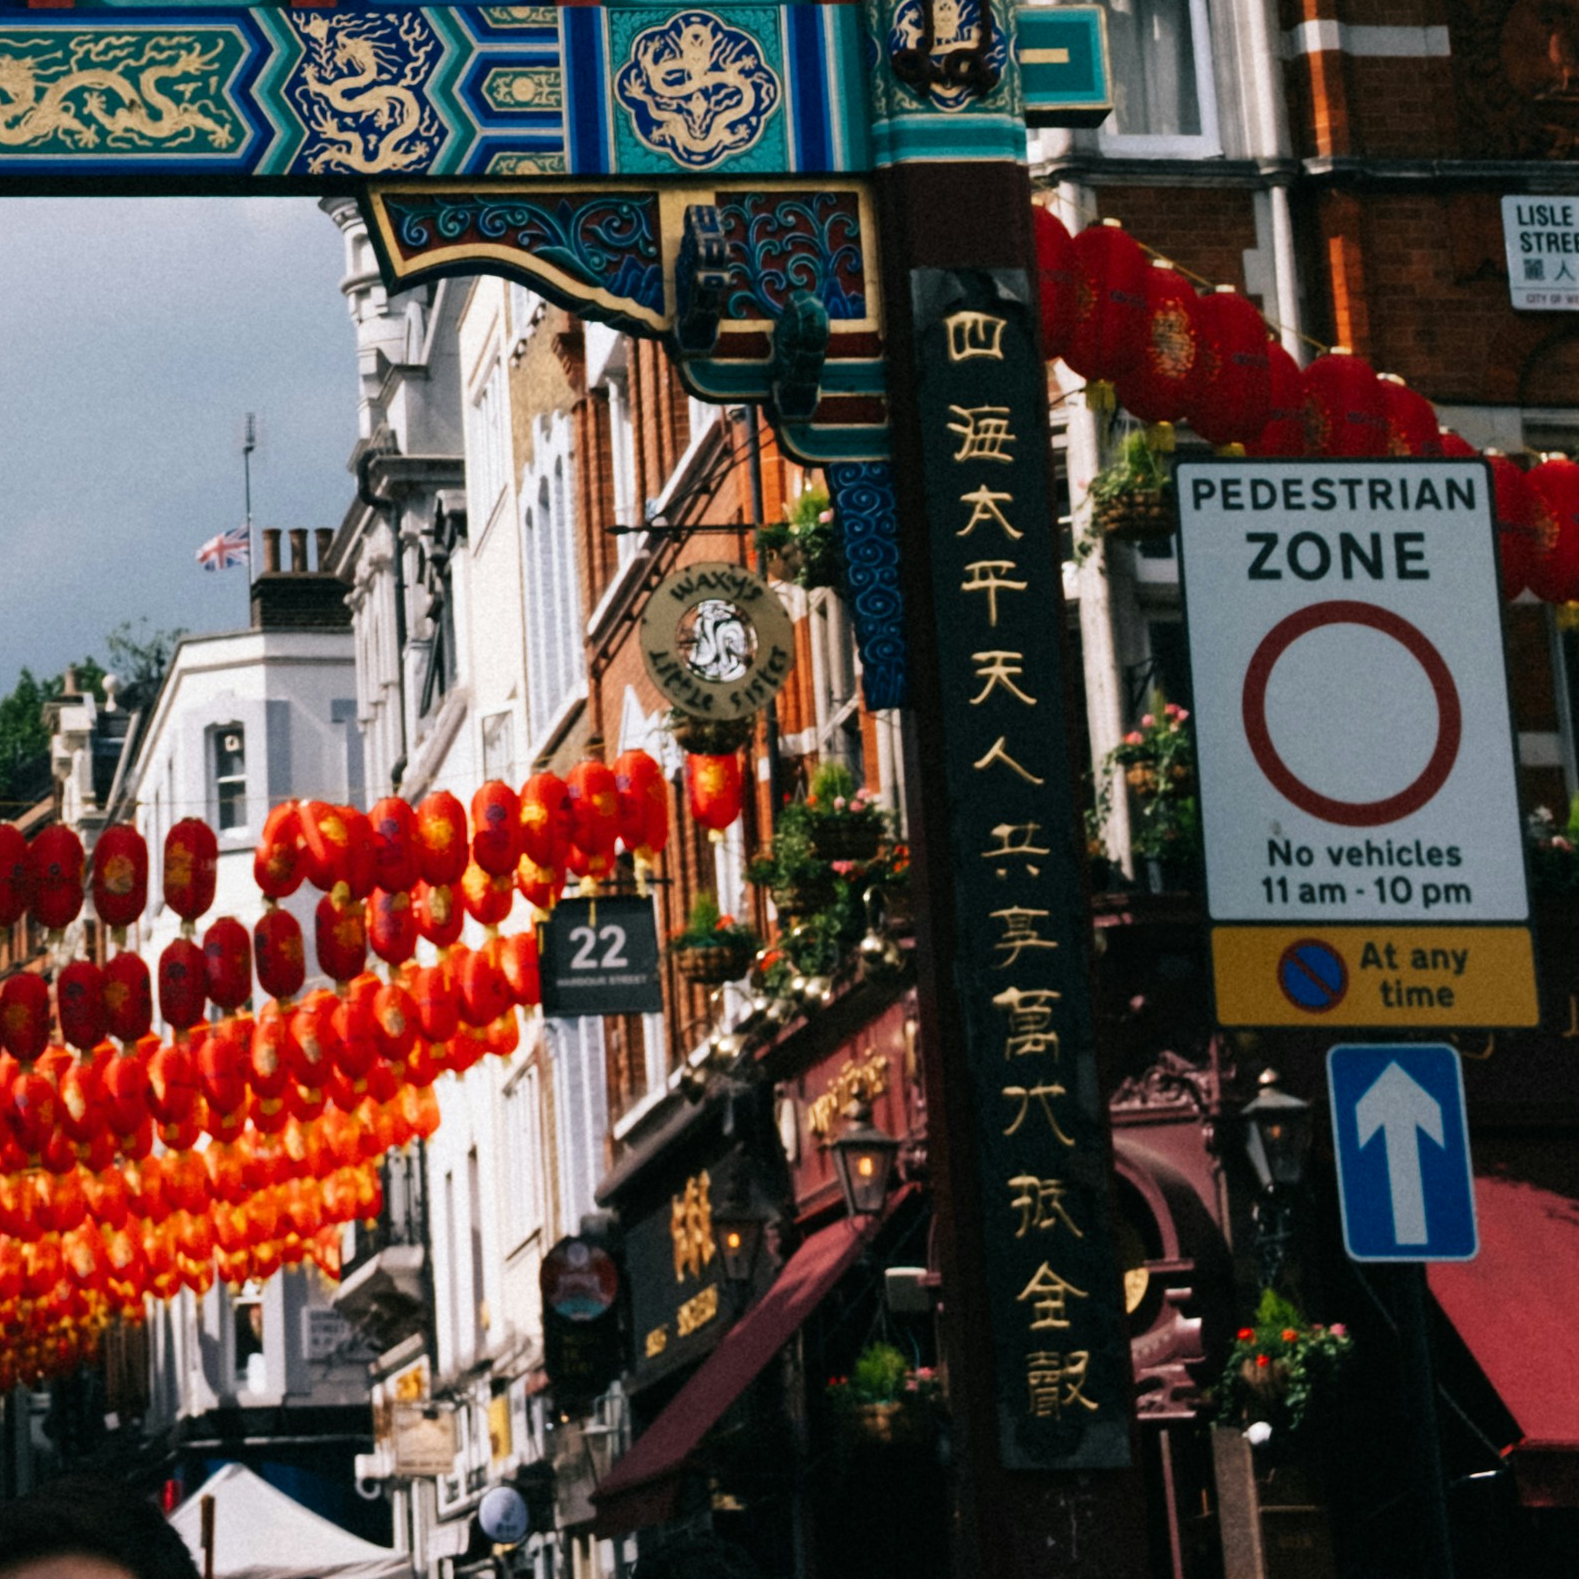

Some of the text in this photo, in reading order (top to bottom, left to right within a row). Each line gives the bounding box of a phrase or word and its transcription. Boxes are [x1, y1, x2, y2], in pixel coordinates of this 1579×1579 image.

[1516, 204, 1574, 226] LISLE
[1191, 477, 1477, 511] PEDESTRIAN
[1245, 530, 1431, 581] ZONE
[1267, 839, 1463, 868] No vehicles
[1262, 876, 1289, 904] 11
[1298, 882, 1347, 905] am
[1374, 876, 1413, 905] 10
[1422, 881, 1473, 909] pm
[569, 925, 628, 969] 22
[1360, 941, 1469, 975] At any
[1380, 980, 1455, 1008] time
